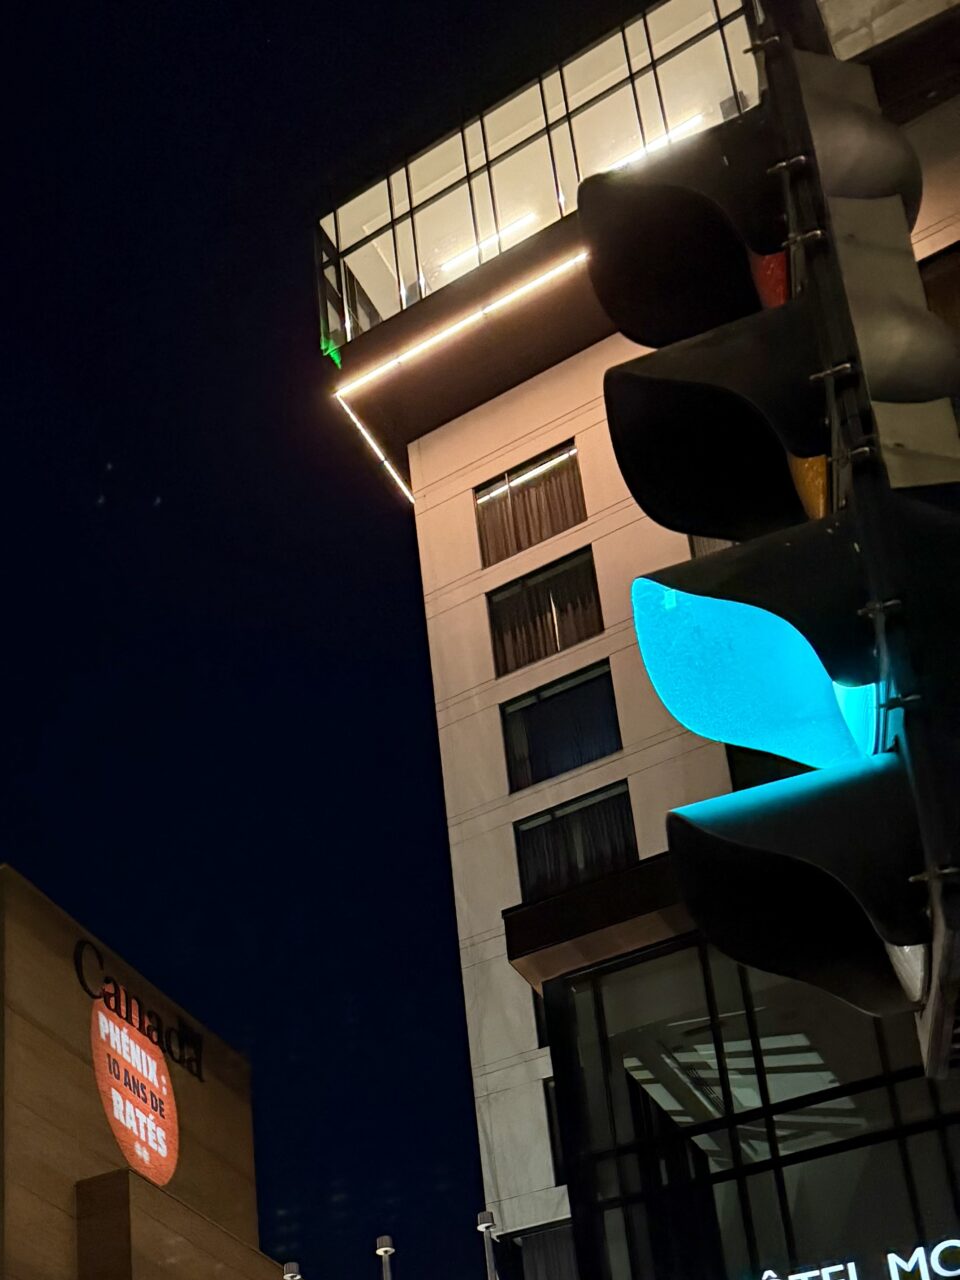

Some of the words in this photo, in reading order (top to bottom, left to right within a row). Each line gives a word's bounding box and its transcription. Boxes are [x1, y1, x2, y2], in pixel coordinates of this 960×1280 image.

[74, 940, 205, 1082] Canada
[97, 1010, 159, 1088] PHÉNIX
[106, 1053, 121, 1081] 10
[123, 1068, 148, 1105] ANS
[150, 1089, 165, 1119] DE
[111, 1087, 168, 1158] RATÉS
